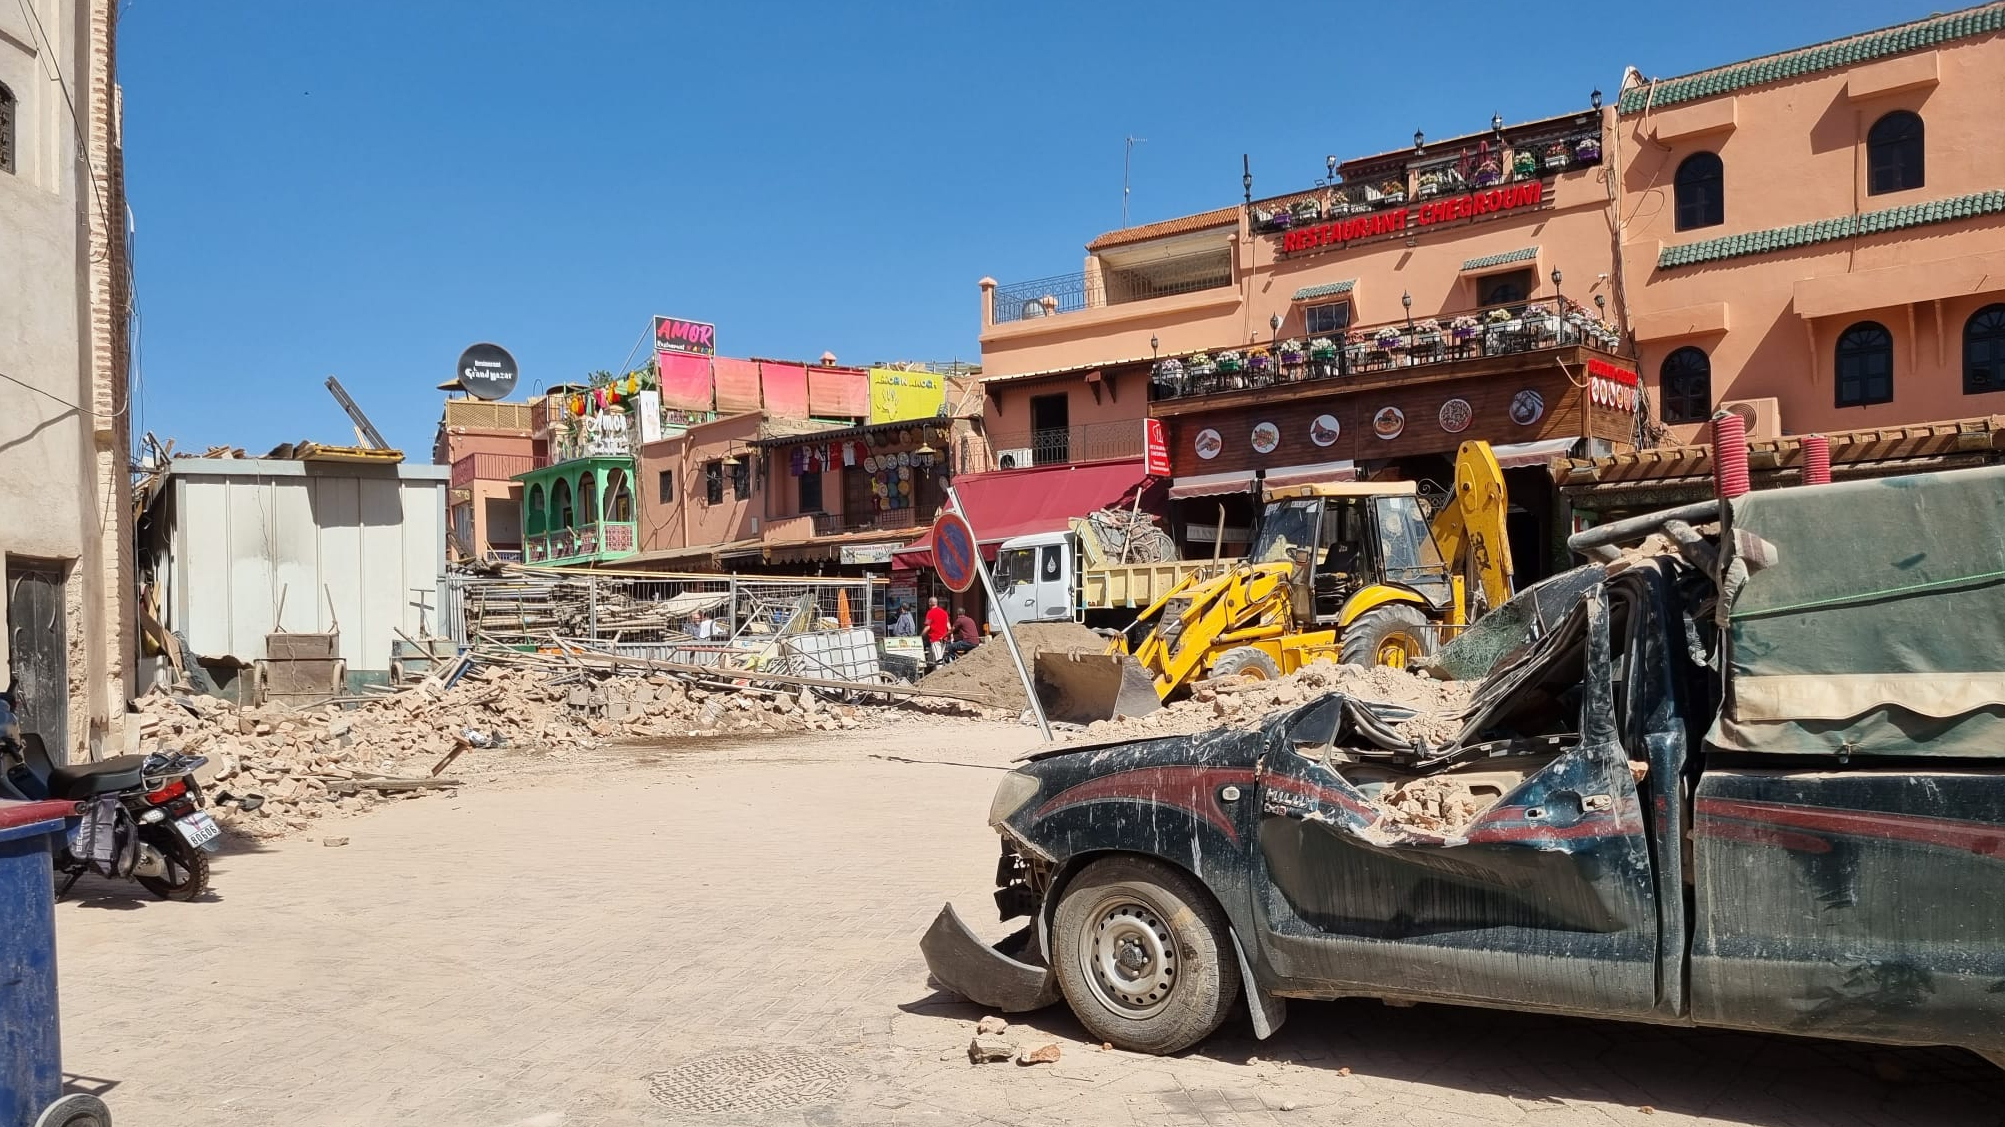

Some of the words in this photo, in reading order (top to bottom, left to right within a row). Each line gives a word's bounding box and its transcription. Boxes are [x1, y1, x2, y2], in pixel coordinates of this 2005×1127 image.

[1283, 207, 1410, 251] RESTAURANT
[1418, 180, 1543, 226] CHEGROUNI
[657, 319, 713, 348] AMOR
[464, 368, 490, 380] Grand
